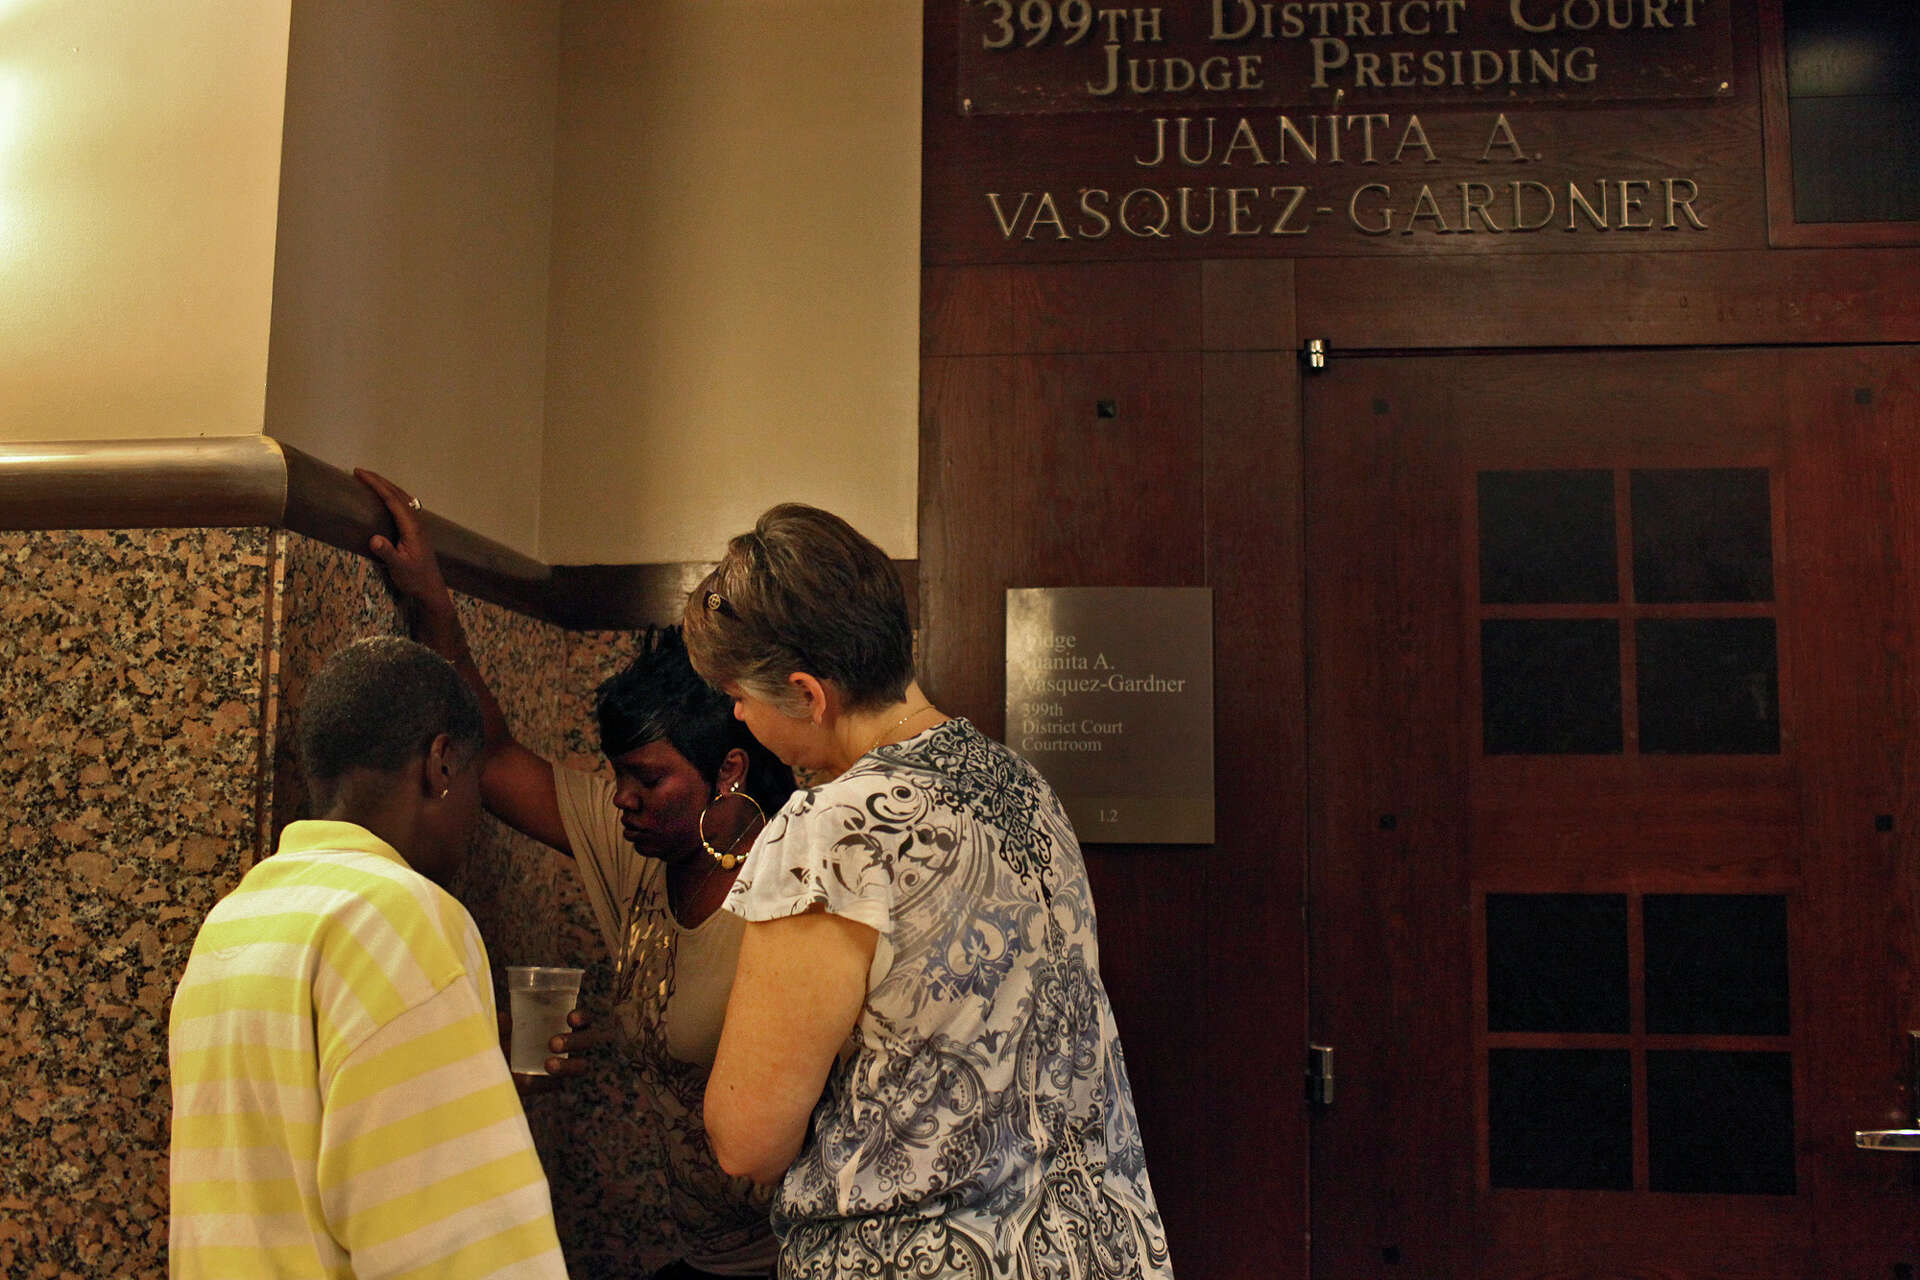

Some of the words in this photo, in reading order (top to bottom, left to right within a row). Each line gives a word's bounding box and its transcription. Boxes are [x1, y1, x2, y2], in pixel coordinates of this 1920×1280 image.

[982, 0, 1162, 50] 399TH
[1208, 0, 1466, 41] DISTRICT
[1510, 0, 1703, 33] COURT
[1087, 44, 1264, 96] JUDGE
[1309, 37, 1599, 89] PRESIDING
[1135, 114, 1442, 167] JUANITA
[1478, 113, 1542, 165] A.
[985, 178, 1709, 239] VASQUEZ-GARDNER
[1093, 653, 1116, 670] A.
[1023, 674, 1186, 697] Vasquez-Gardner
[1022, 703, 1064, 718] 399th
[1023, 719, 1077, 735] District
[1081, 719, 1123, 735] Court
[1022, 737, 1102, 752] Courtroom
